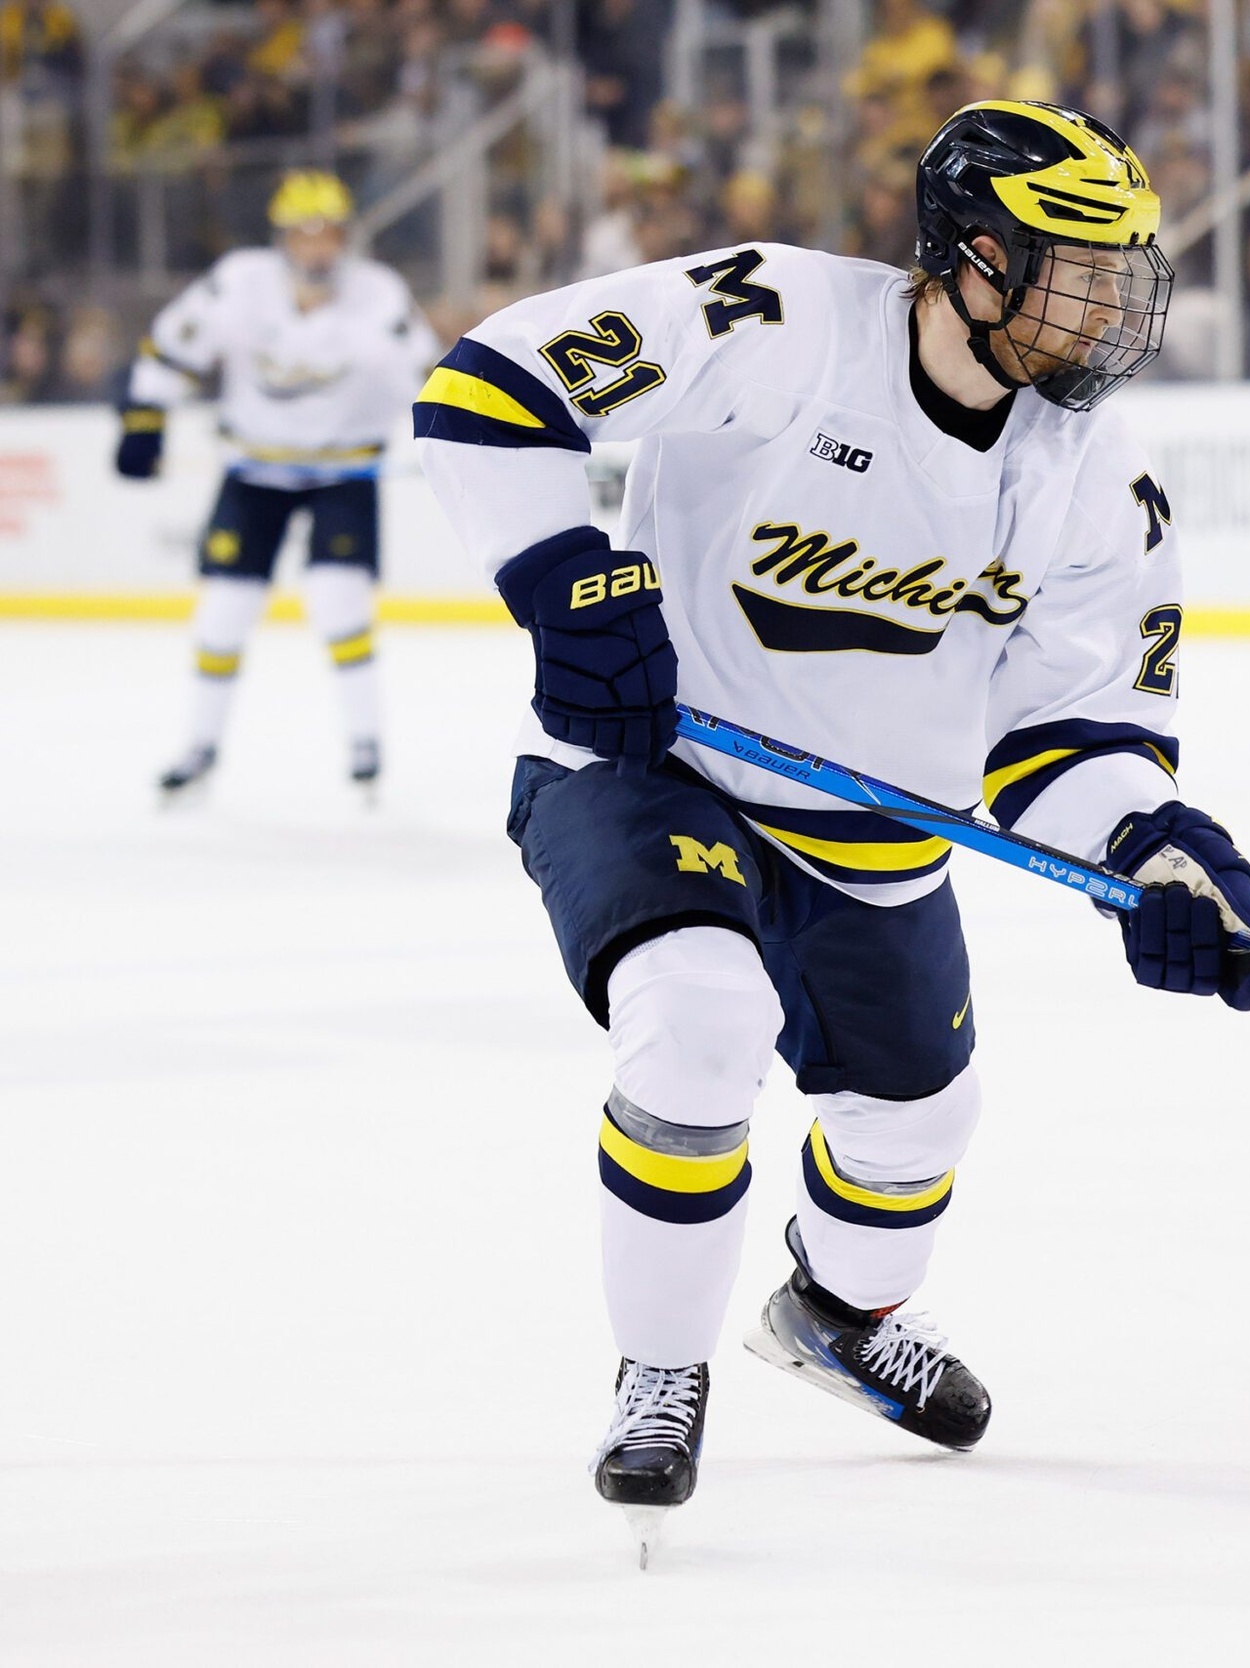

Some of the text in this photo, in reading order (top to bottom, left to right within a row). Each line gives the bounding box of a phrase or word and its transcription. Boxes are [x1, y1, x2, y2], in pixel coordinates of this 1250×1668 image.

[682, 248, 785, 340] M
[538, 310, 667, 418] 21
[669, 834, 747, 887] M
[1110, 822, 1134, 854] MACH
